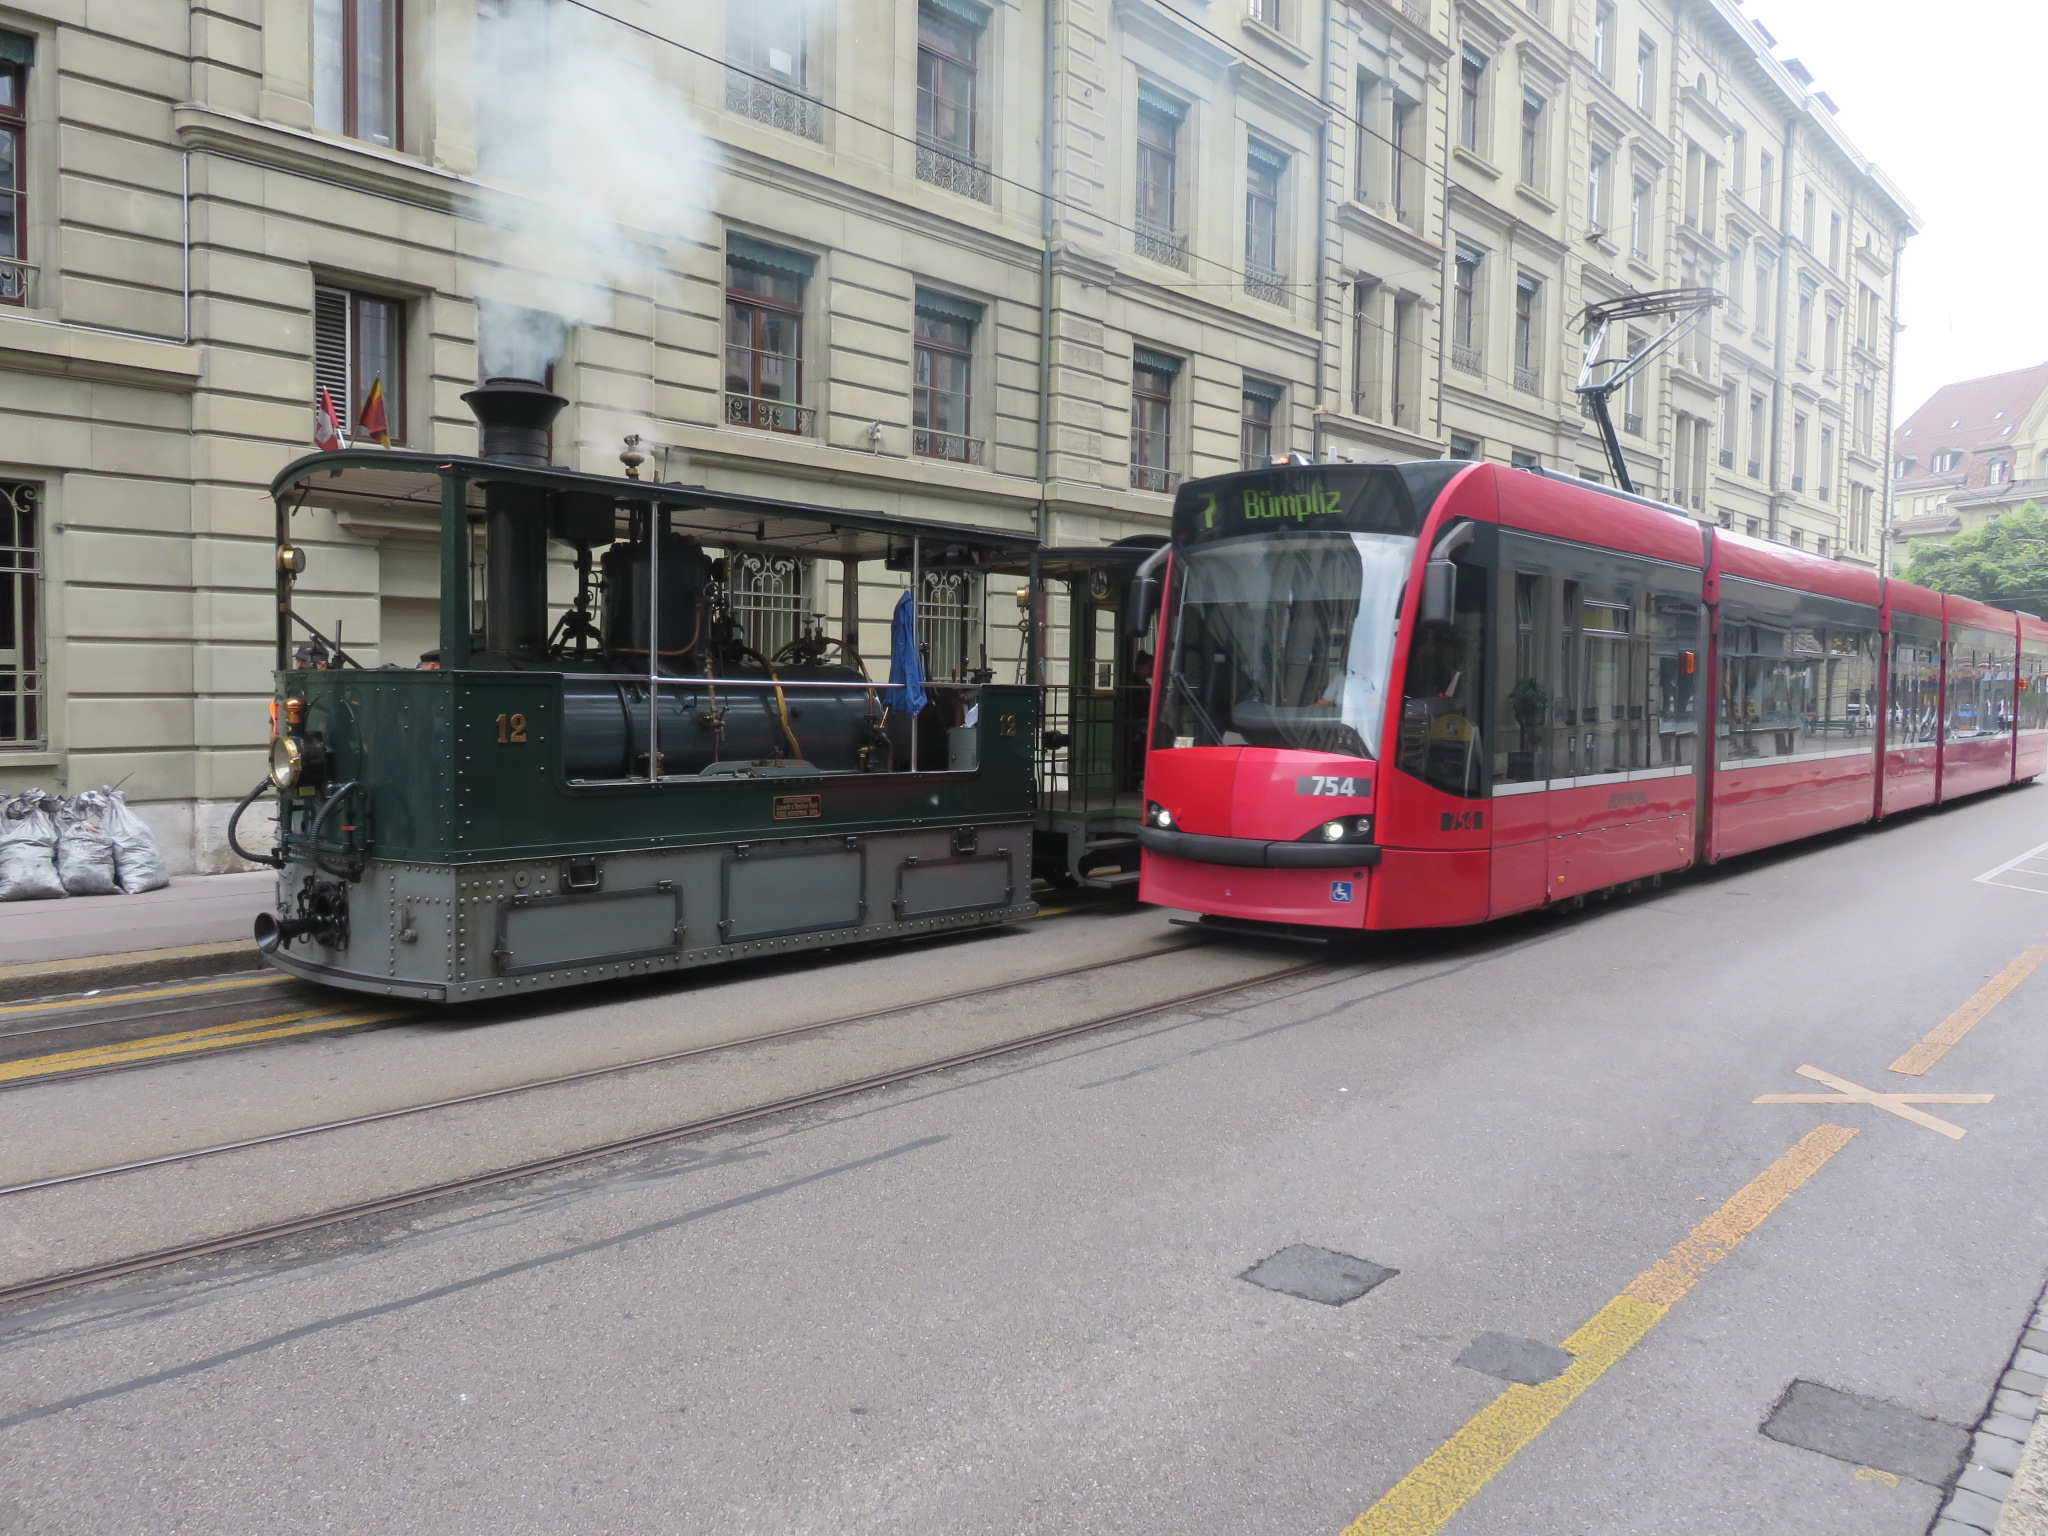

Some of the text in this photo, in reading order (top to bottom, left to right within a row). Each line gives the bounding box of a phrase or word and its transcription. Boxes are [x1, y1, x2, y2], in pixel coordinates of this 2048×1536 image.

[1198, 485, 1342, 528] 7 Bümpliz
[495, 713, 528, 743] 12
[1311, 775, 1356, 797] 754
